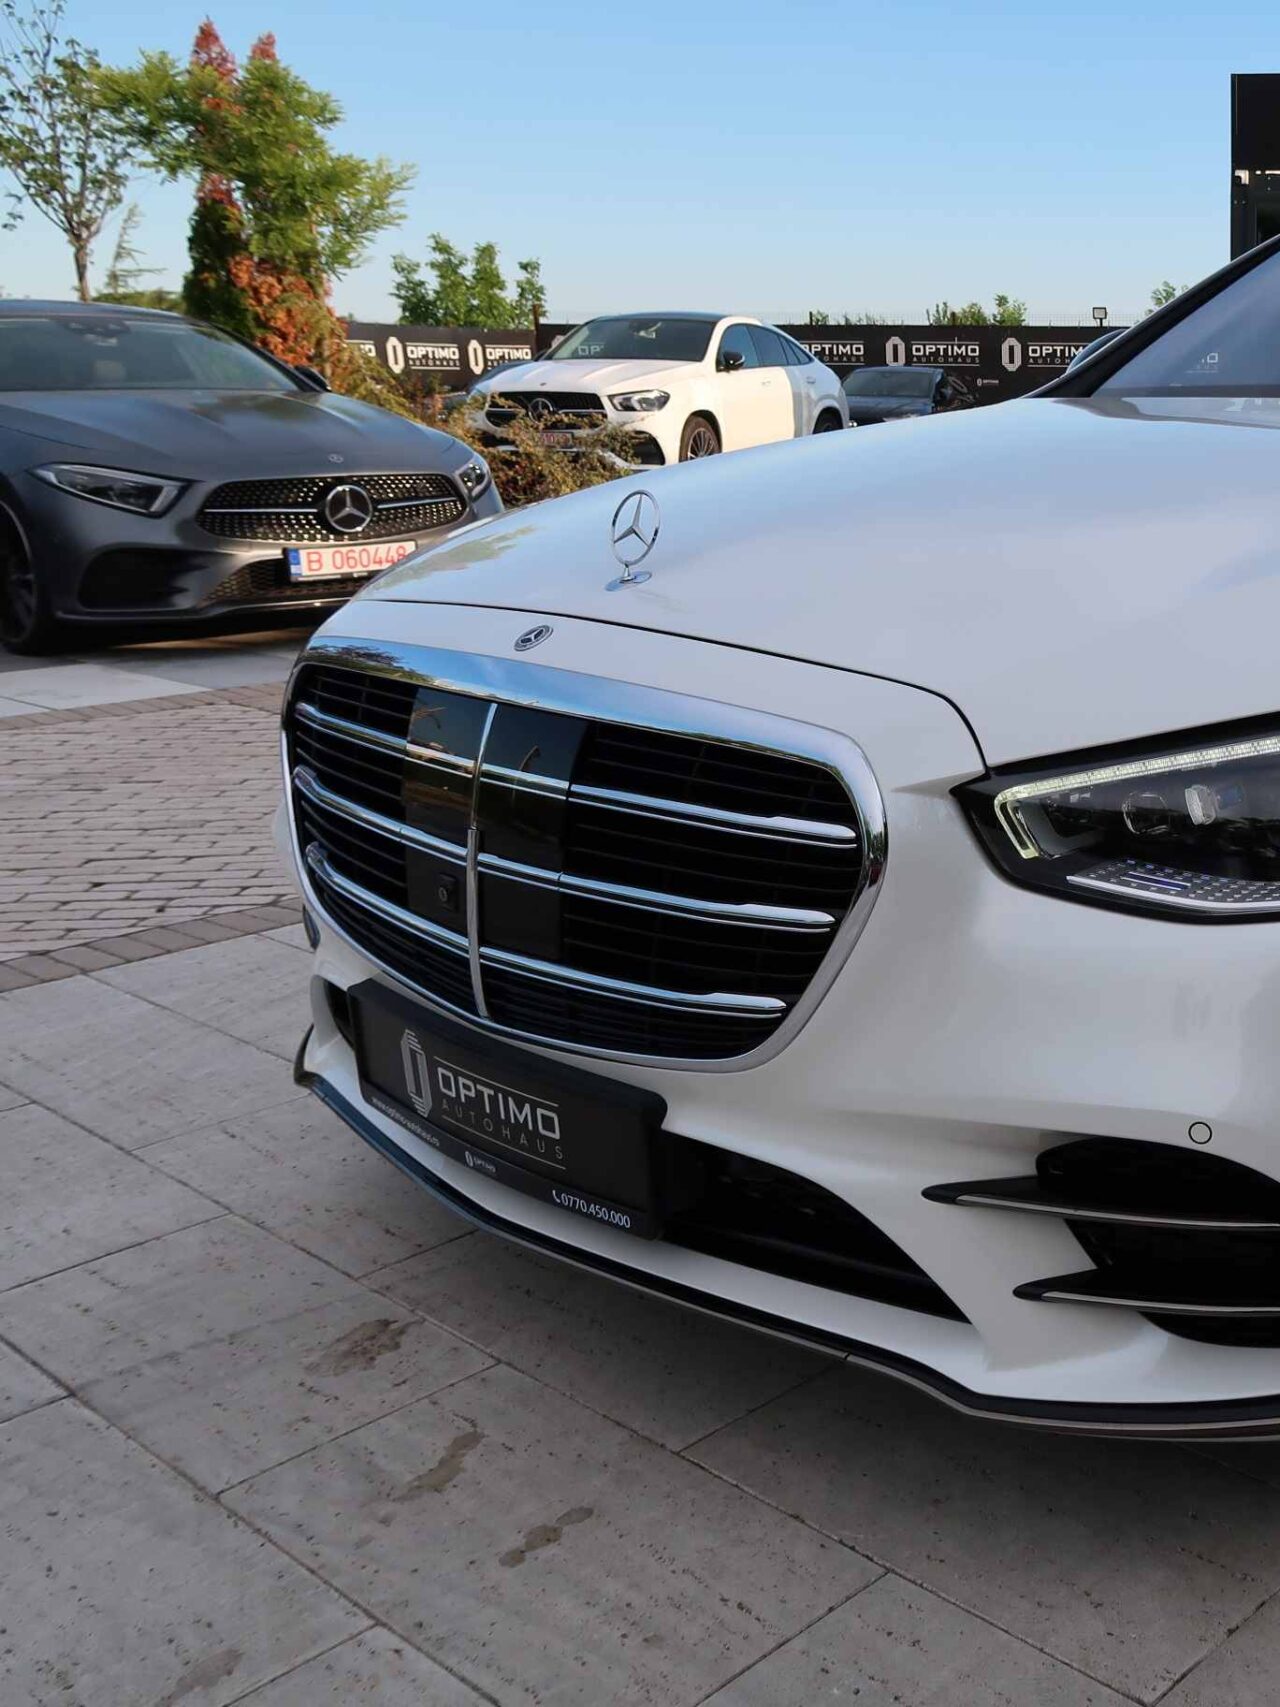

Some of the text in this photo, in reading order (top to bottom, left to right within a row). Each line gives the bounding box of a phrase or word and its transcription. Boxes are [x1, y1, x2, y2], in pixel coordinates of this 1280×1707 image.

[406, 345, 460, 360] OPTIMO
[486, 348, 532, 360] OPTIMO
[912, 344, 980, 357] OPTIMO
[1028, 345, 1084, 357] OPTIM
[306, 551, 323, 572] B
[437, 1066, 561, 1140] OPTIMO
[441, 1098, 564, 1160] AUTOHAUS
[560, 1192, 631, 1228] 0770.450.000
